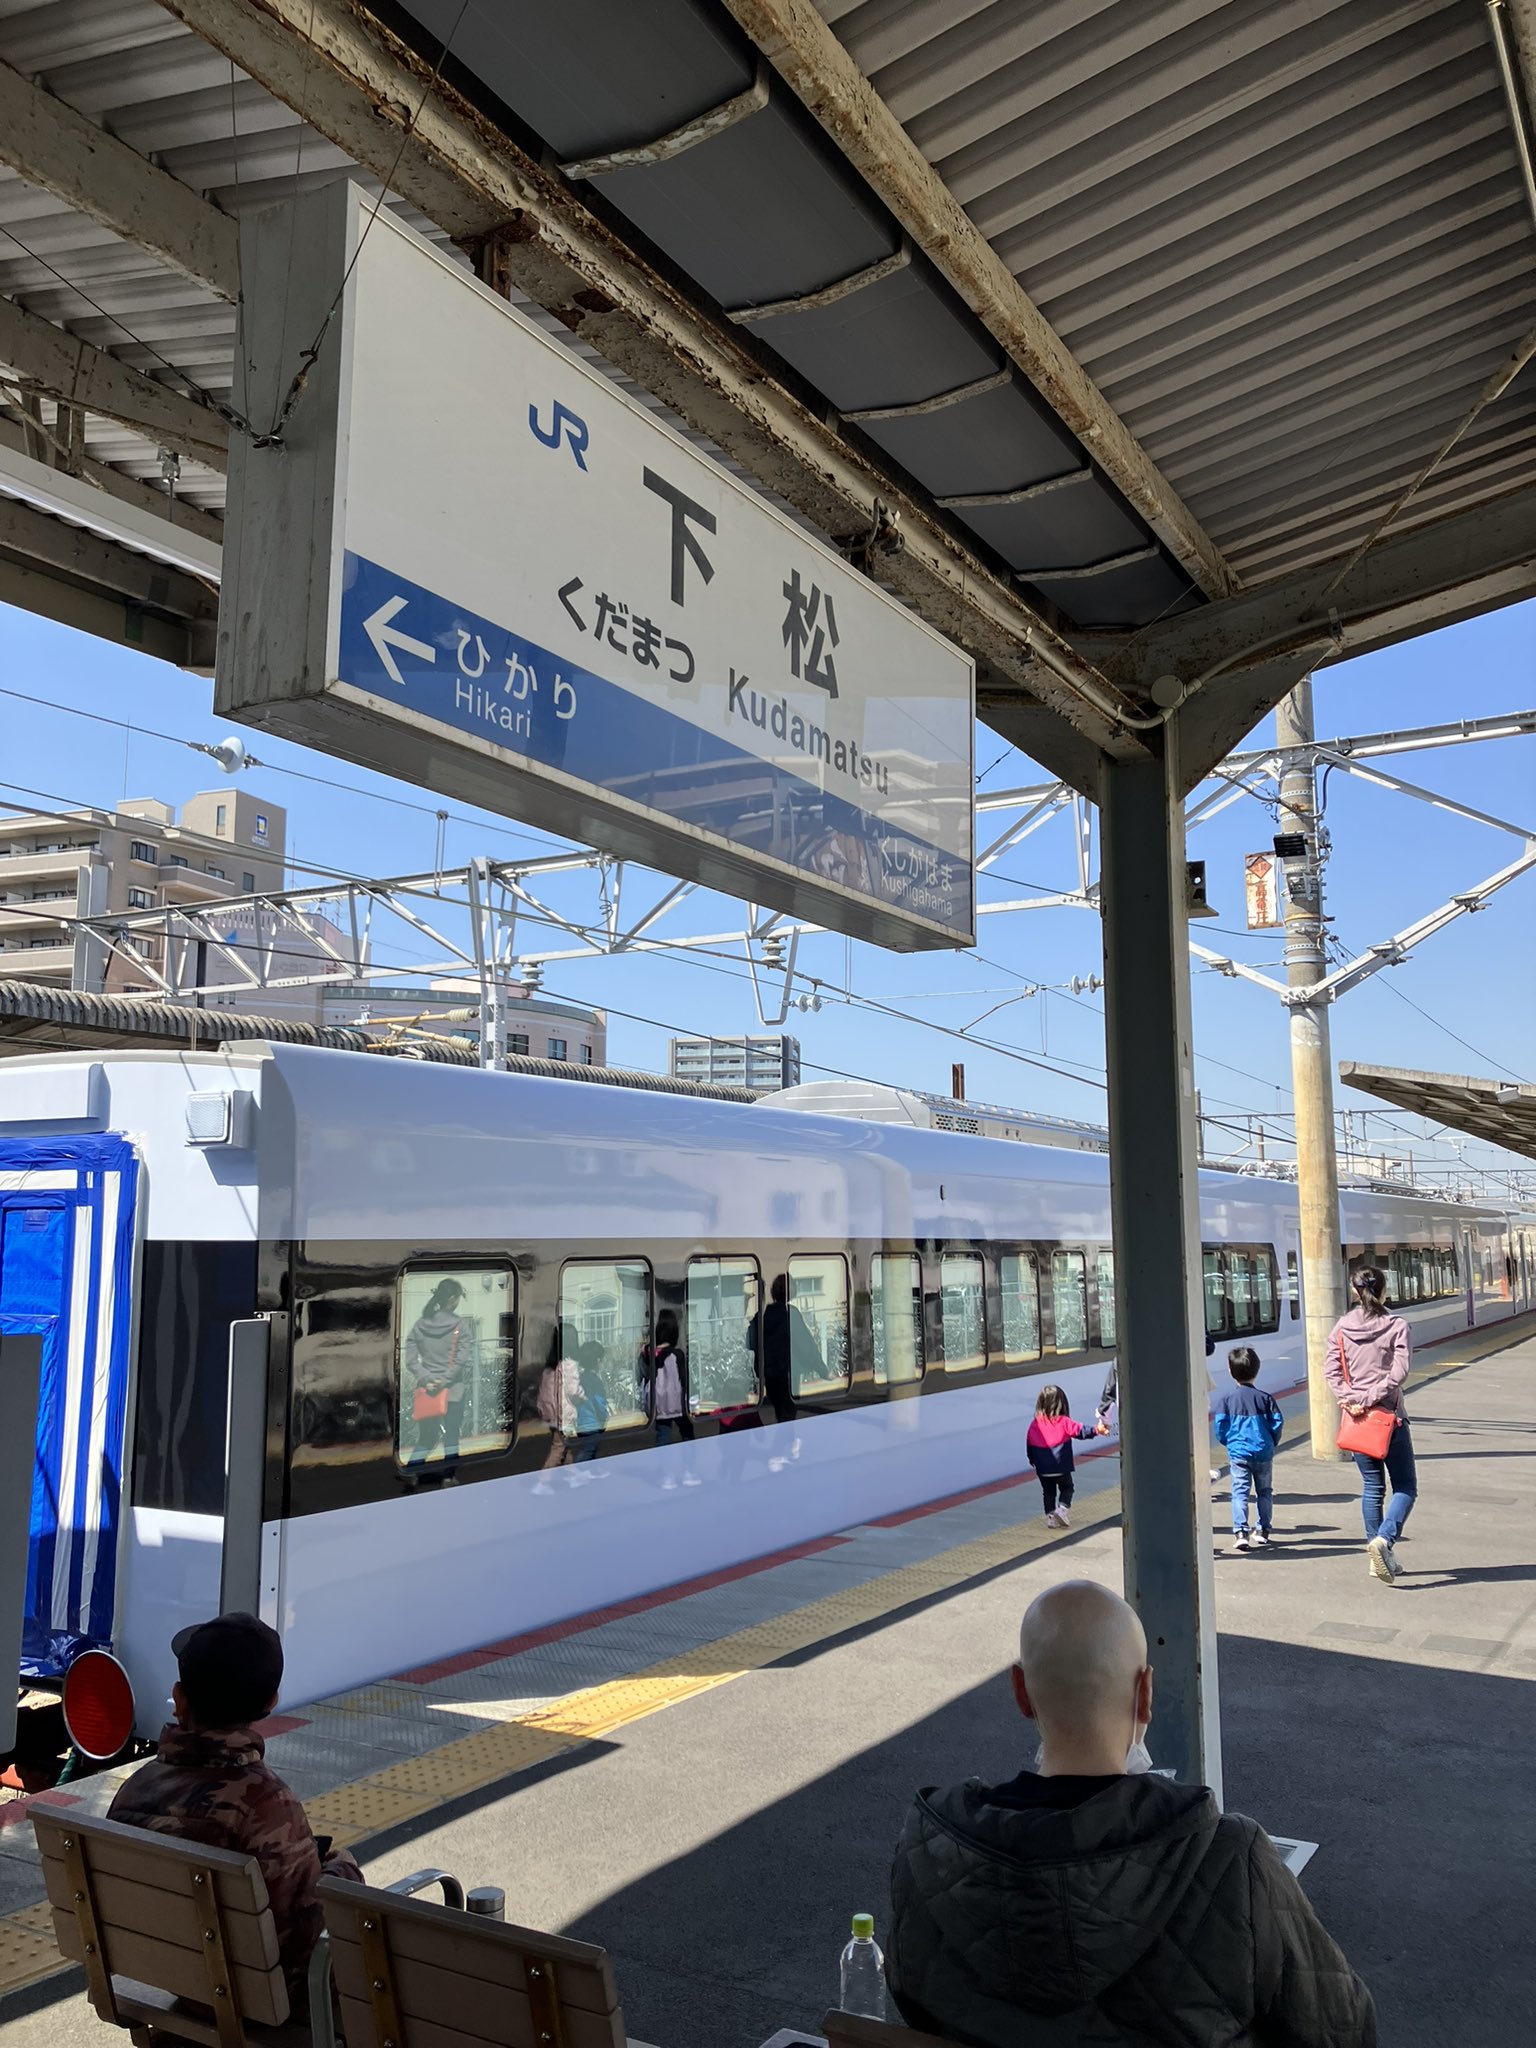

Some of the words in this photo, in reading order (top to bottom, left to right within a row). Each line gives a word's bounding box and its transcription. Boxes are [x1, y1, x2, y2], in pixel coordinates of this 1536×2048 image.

[529, 399, 589, 473] JR
[557, 576, 695, 683] くだまつ
[455, 678, 531, 738] Hikari
[457, 628, 577, 720] ひかり
[729, 667, 888, 795] Kudamatsu
[881, 835, 953, 892] くしがはま
[881, 869, 953, 916] Kushigahama
